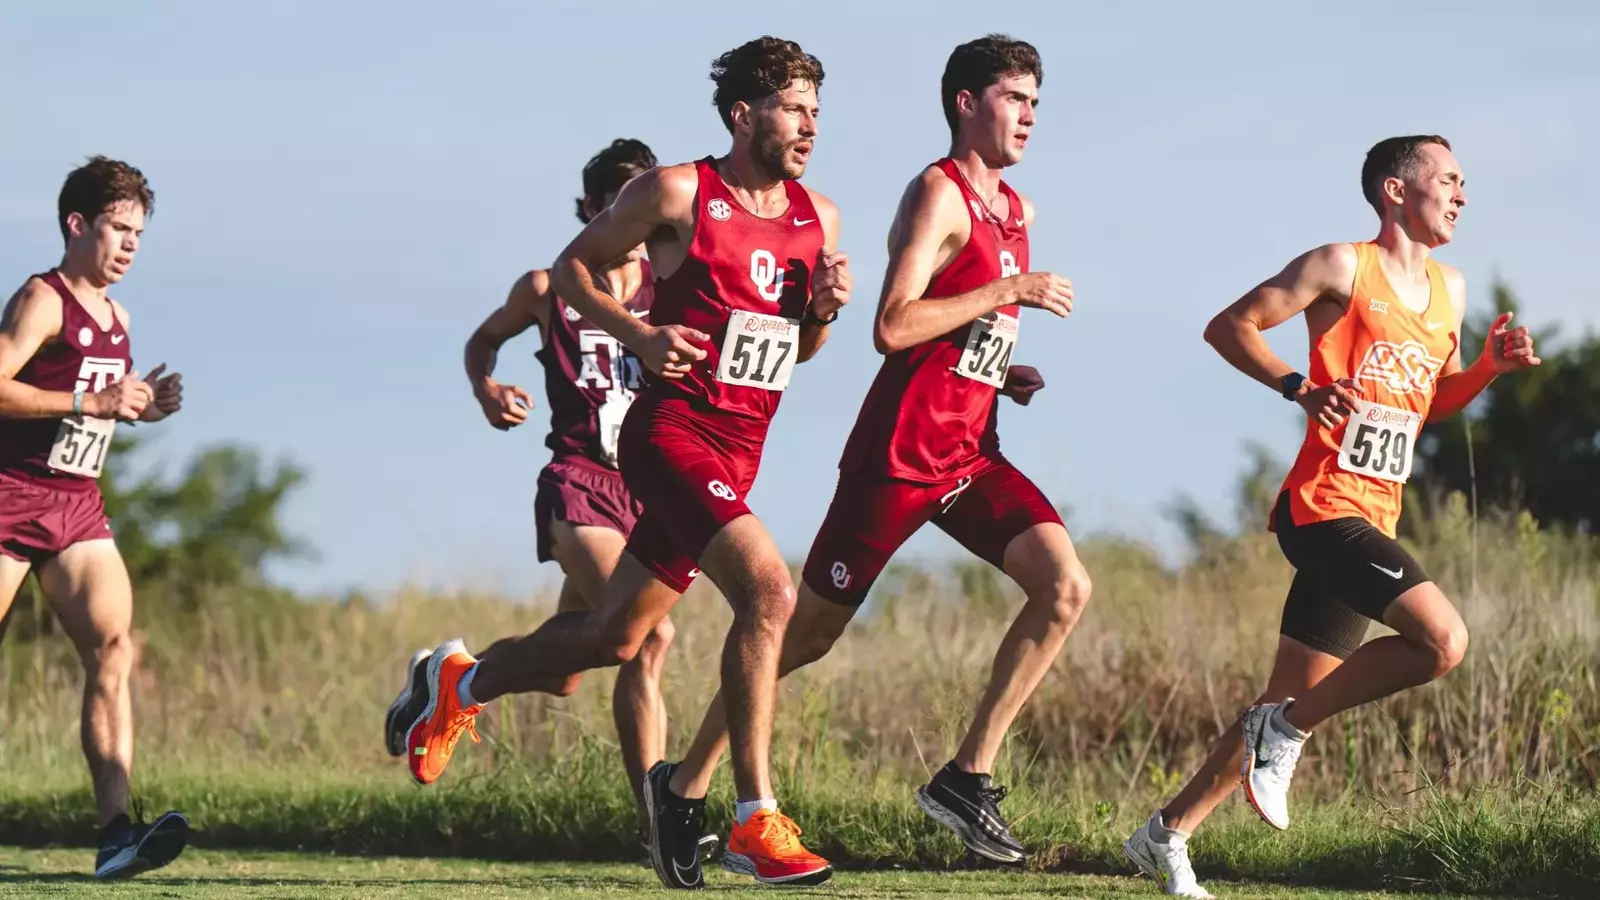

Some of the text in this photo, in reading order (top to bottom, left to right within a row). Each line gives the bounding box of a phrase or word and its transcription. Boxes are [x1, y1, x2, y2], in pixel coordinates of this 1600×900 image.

[750, 248, 785, 302] OU
[728, 333, 792, 384] 517
[968, 331, 1014, 382] 524
[61, 428, 107, 471] 571
[1349, 423, 1408, 477] 539
[707, 478, 737, 501] OU
[830, 561, 852, 589] OU
